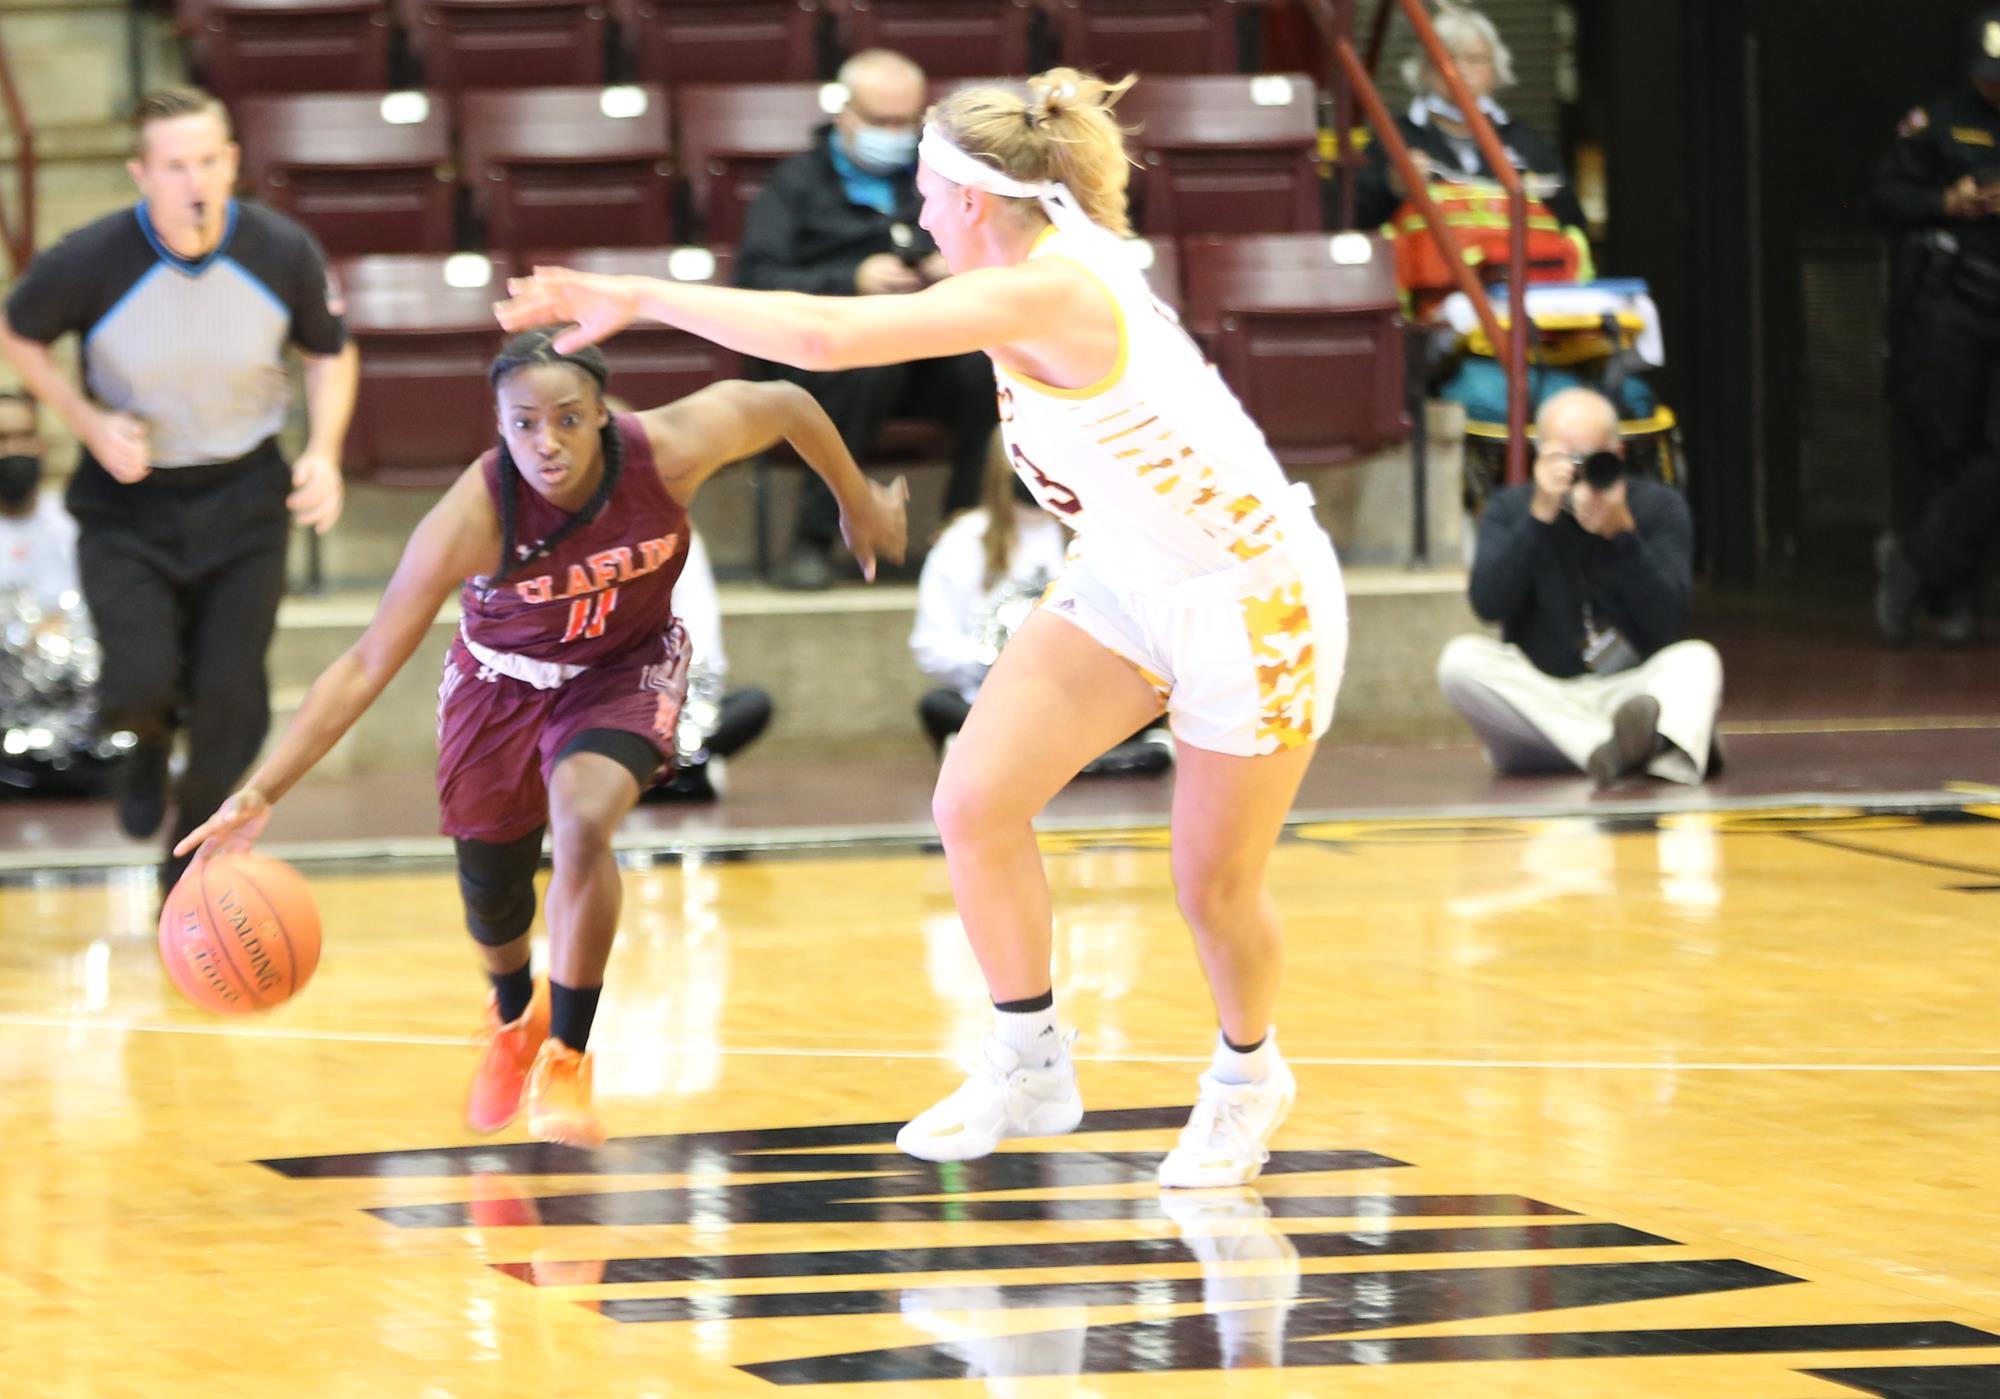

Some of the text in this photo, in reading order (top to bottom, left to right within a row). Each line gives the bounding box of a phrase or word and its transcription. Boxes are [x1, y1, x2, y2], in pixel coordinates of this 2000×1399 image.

[515, 533, 678, 603] CLAFLIN
[559, 587, 618, 643] 11
[218, 887, 283, 991] SPALDING
